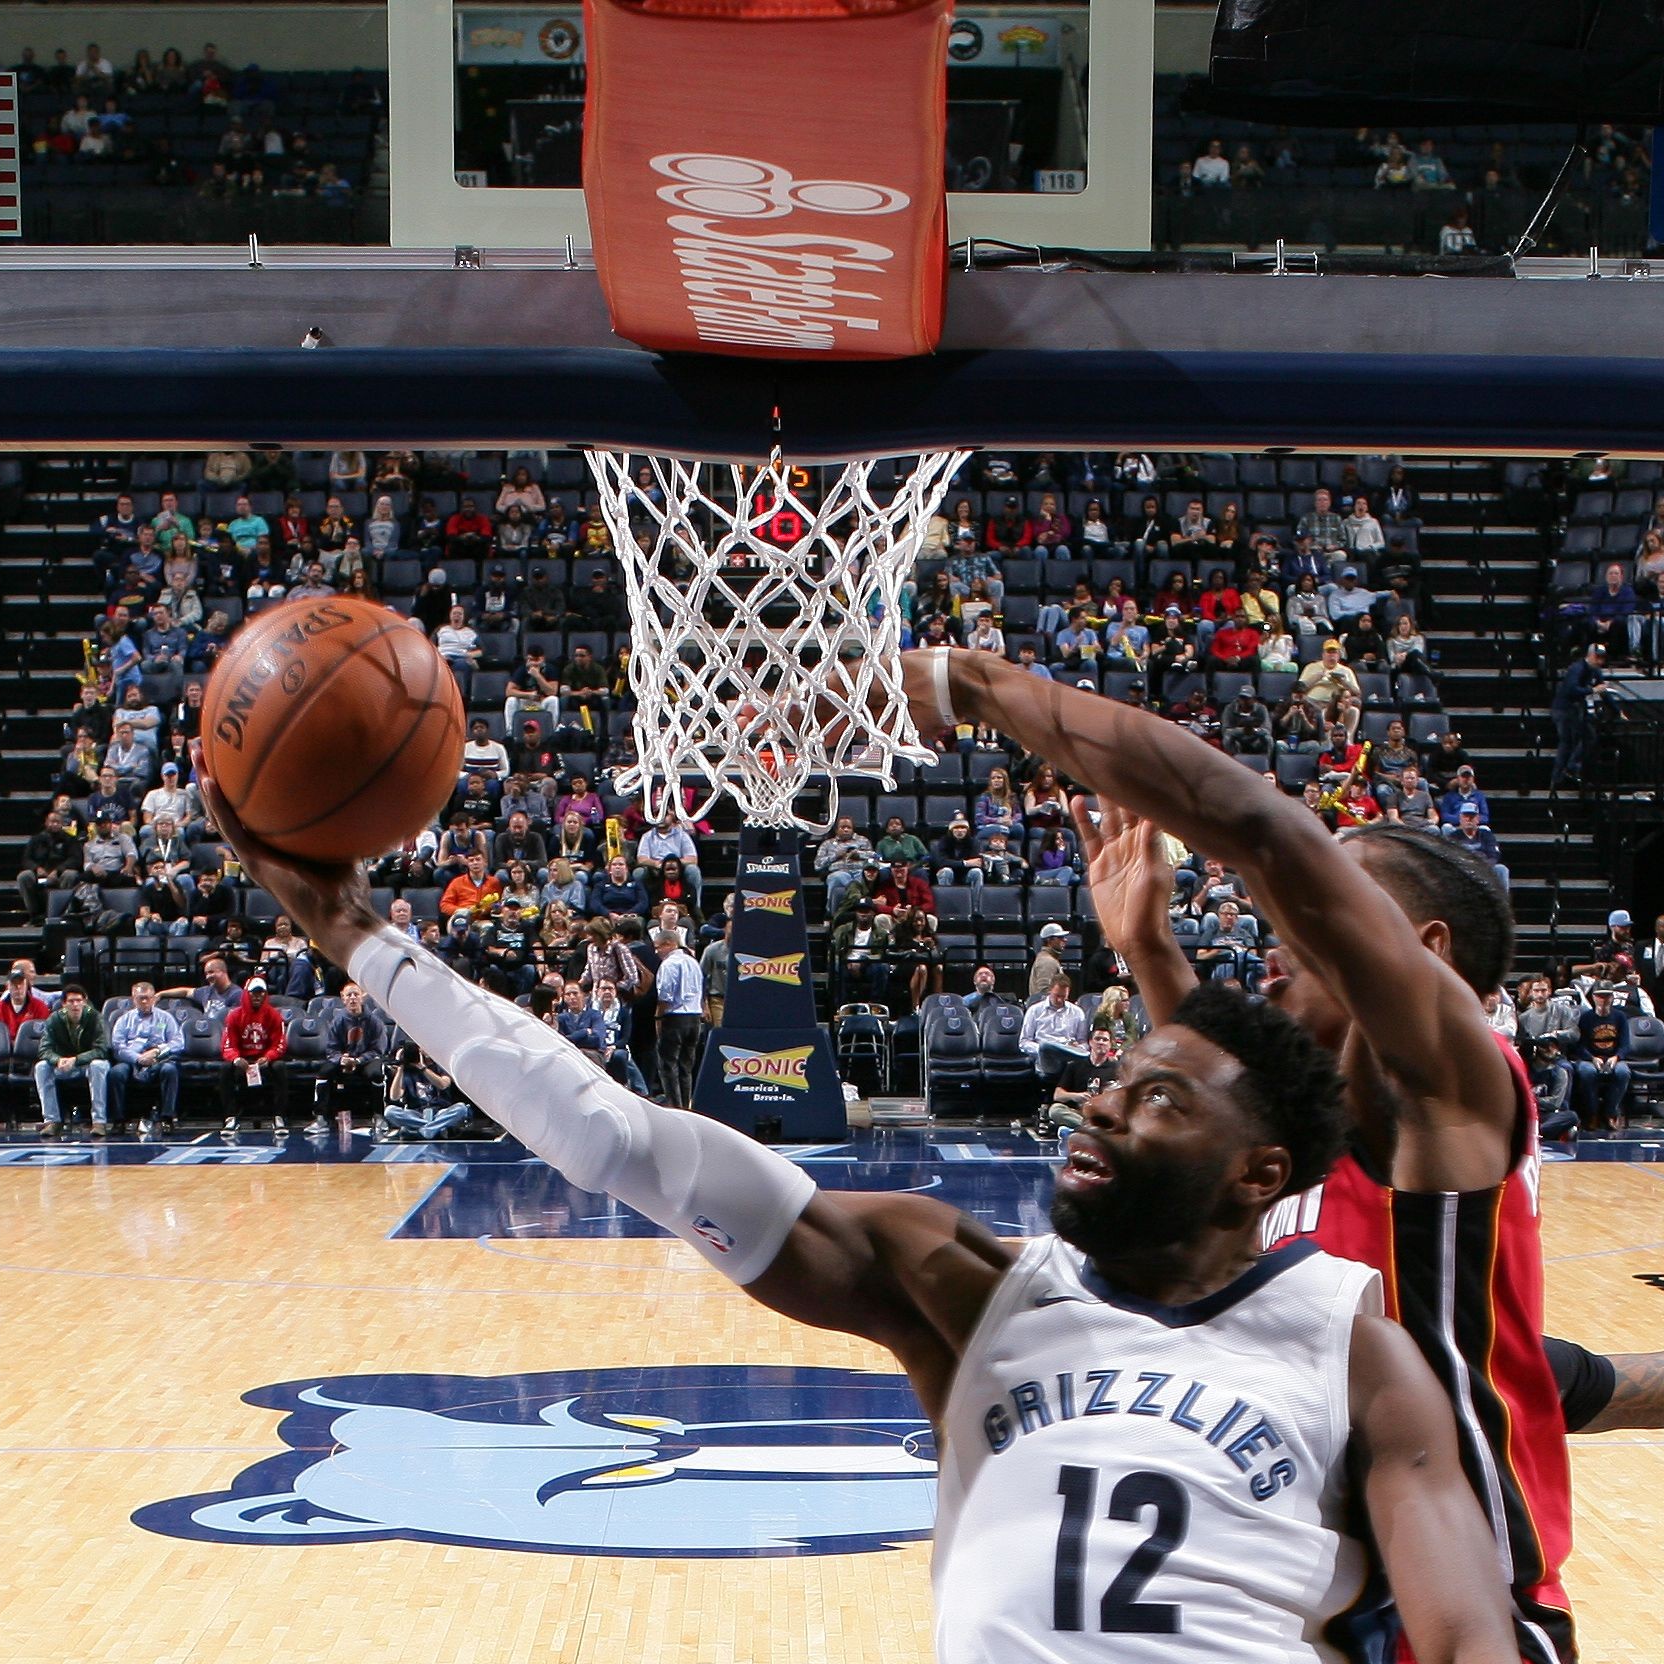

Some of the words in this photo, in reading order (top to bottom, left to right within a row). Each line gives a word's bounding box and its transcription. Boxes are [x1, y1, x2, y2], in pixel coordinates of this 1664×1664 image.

[1048, 174, 1076, 189] 118
[746, 862, 789, 874] SPALDING
[744, 895, 793, 909] SONIC
[741, 961, 800, 976] SONIC
[729, 1057, 807, 1076] SONIC
[733, 1083, 779, 1092] America's
[982, 1369, 1298, 1502] GRIZZLIES
[1052, 1464, 1193, 1633] 12
